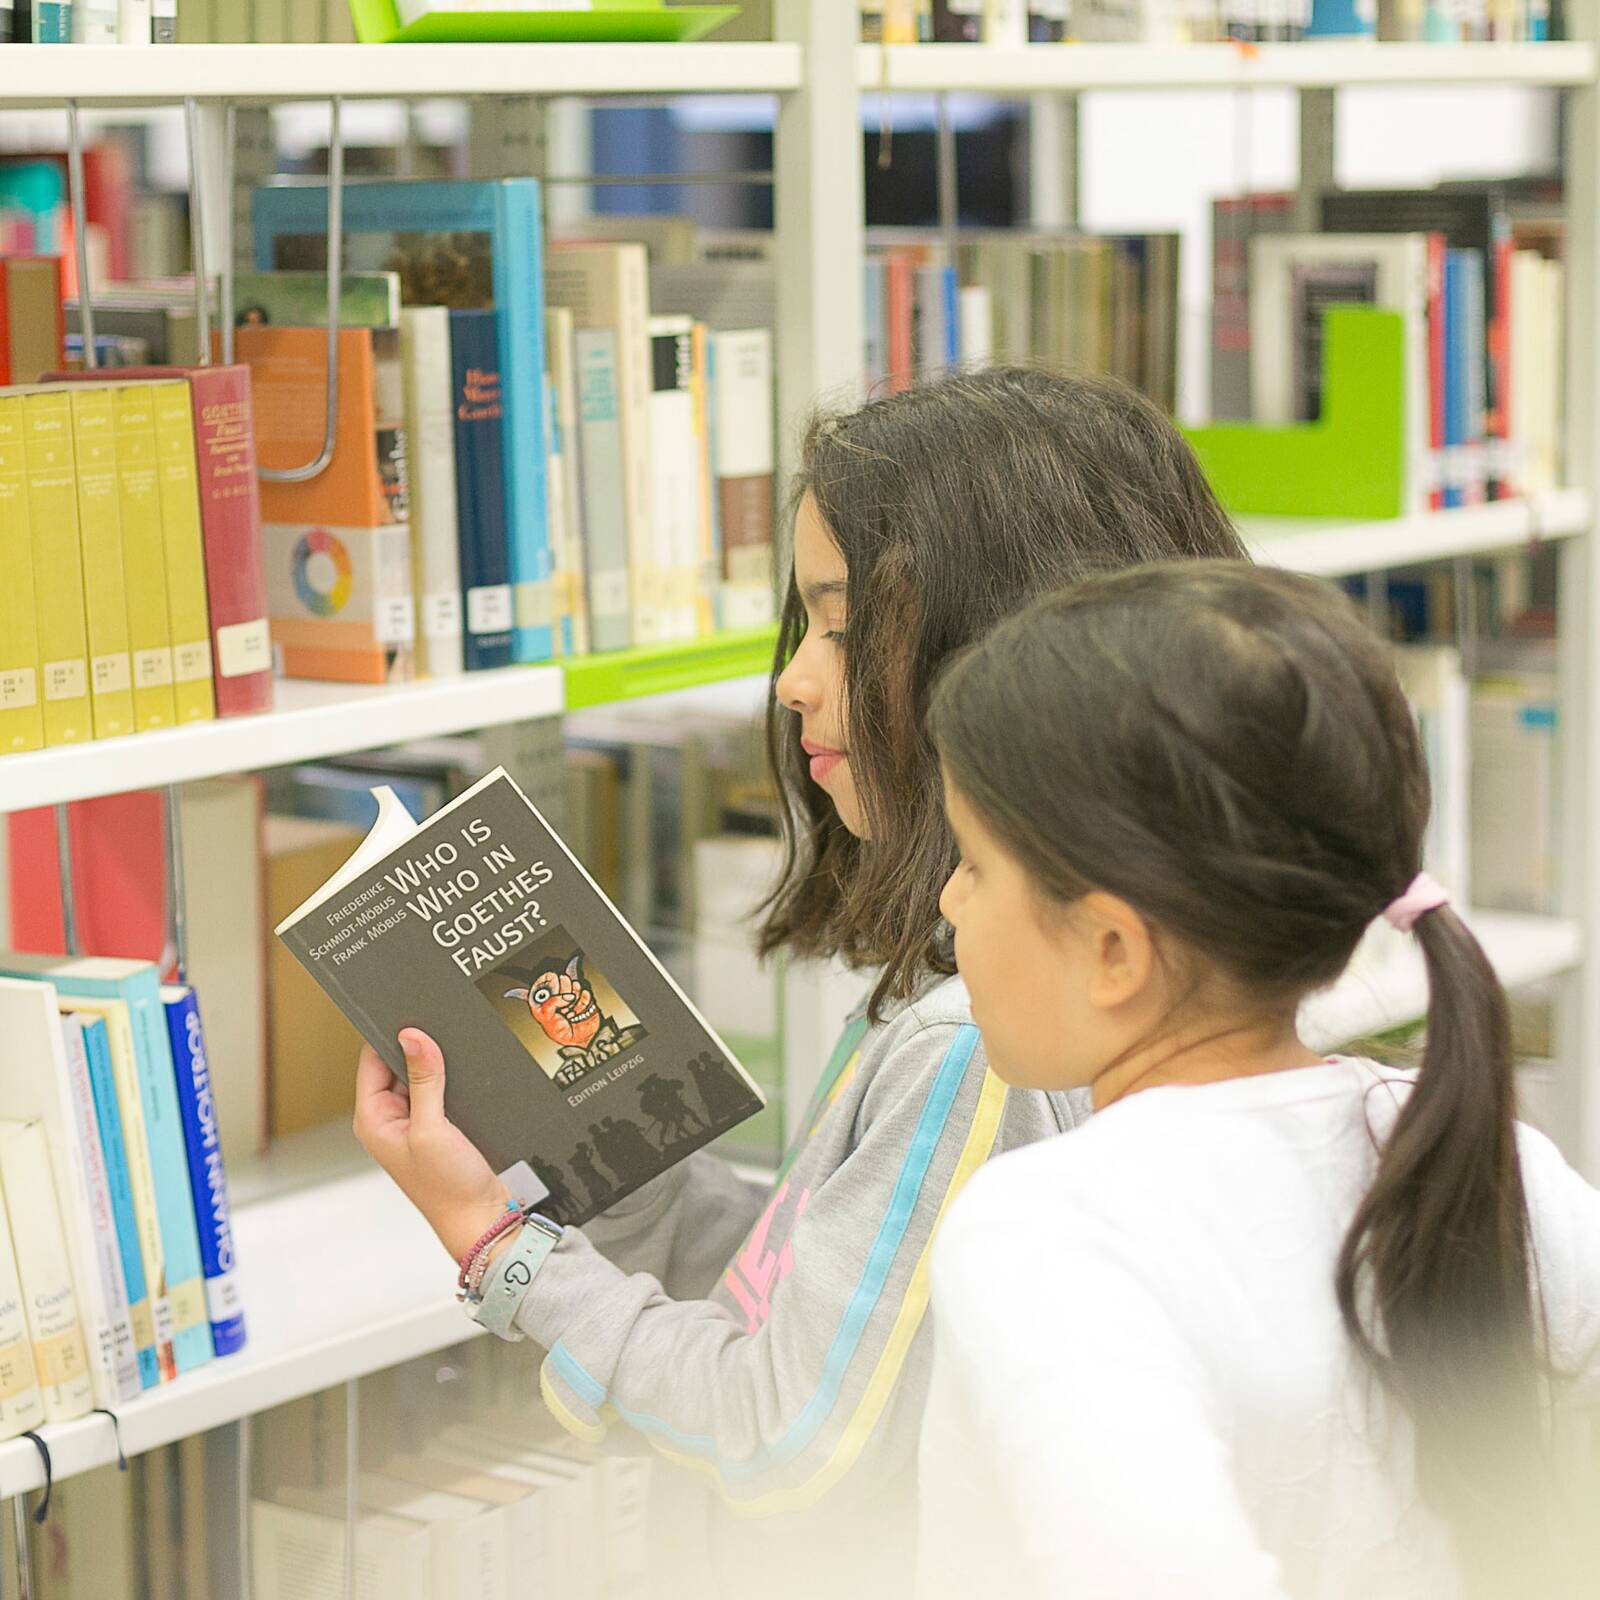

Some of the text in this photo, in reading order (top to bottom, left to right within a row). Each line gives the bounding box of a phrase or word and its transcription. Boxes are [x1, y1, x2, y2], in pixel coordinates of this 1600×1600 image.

[384, 818, 492, 895] WHO IS
[405, 843, 517, 922] WHO IN
[308, 895, 397, 961] SCHMIDT-MÖBUS
[326, 881, 386, 927] FRIEDERIKE
[332, 908, 408, 966] FRANK MÖBUS
[432, 861, 553, 948] GOETHES
[451, 900, 547, 977] FAUST?
[567, 1054, 645, 1108] EDITION LEIPZIG
[204, 1150, 236, 1272] OHANN
